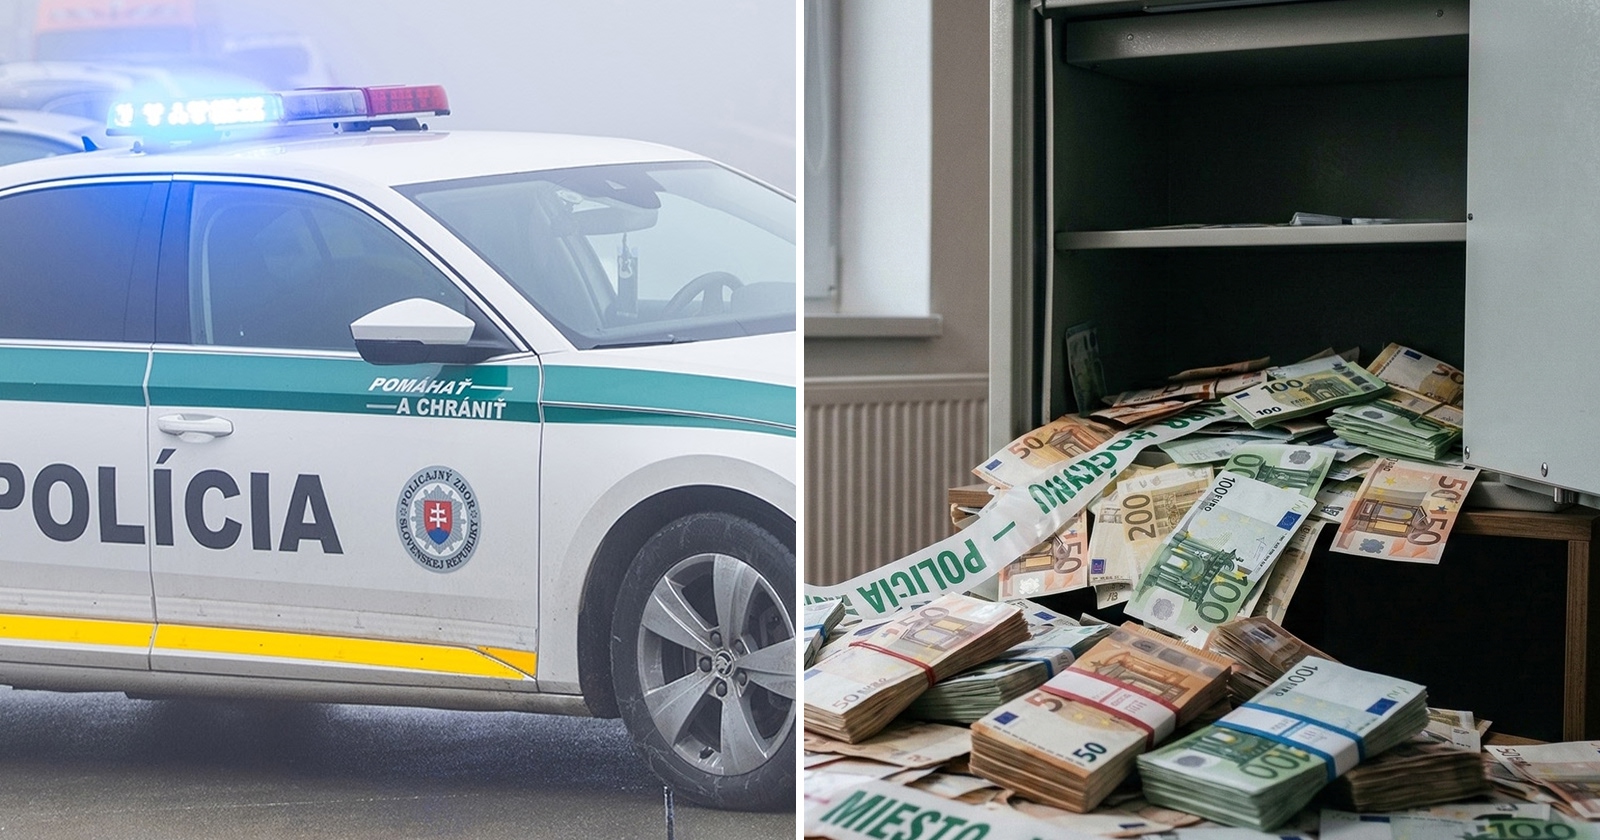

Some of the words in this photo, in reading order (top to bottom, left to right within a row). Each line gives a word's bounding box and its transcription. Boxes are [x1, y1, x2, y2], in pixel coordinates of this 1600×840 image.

[368, 377, 472, 395] POMÁHAŤ
[1260, 379, 1304, 394] 100
[396, 397, 411, 415] A
[416, 397, 507, 419] CHRÁNIŤ
[1256, 406, 1282, 416] 100
[1008, 435, 1044, 460] 50
[401, 469, 453, 507] POLICAJNÝ
[453, 478, 476, 510] ZBOR
[1214, 477, 1236, 496] 100
[1122, 494, 1156, 541] 200
[399, 518, 444, 570] SLOVENSKEJ
[446, 519, 478, 569] REPUBLIKY
[1054, 541, 1082, 574] 50
[1198, 570, 1249, 624] 100
[1287, 665, 1318, 684] 100
[832, 693, 860, 711] 50
[1072, 742, 1108, 763] 50
[1488, 822, 1577, 840] 100
